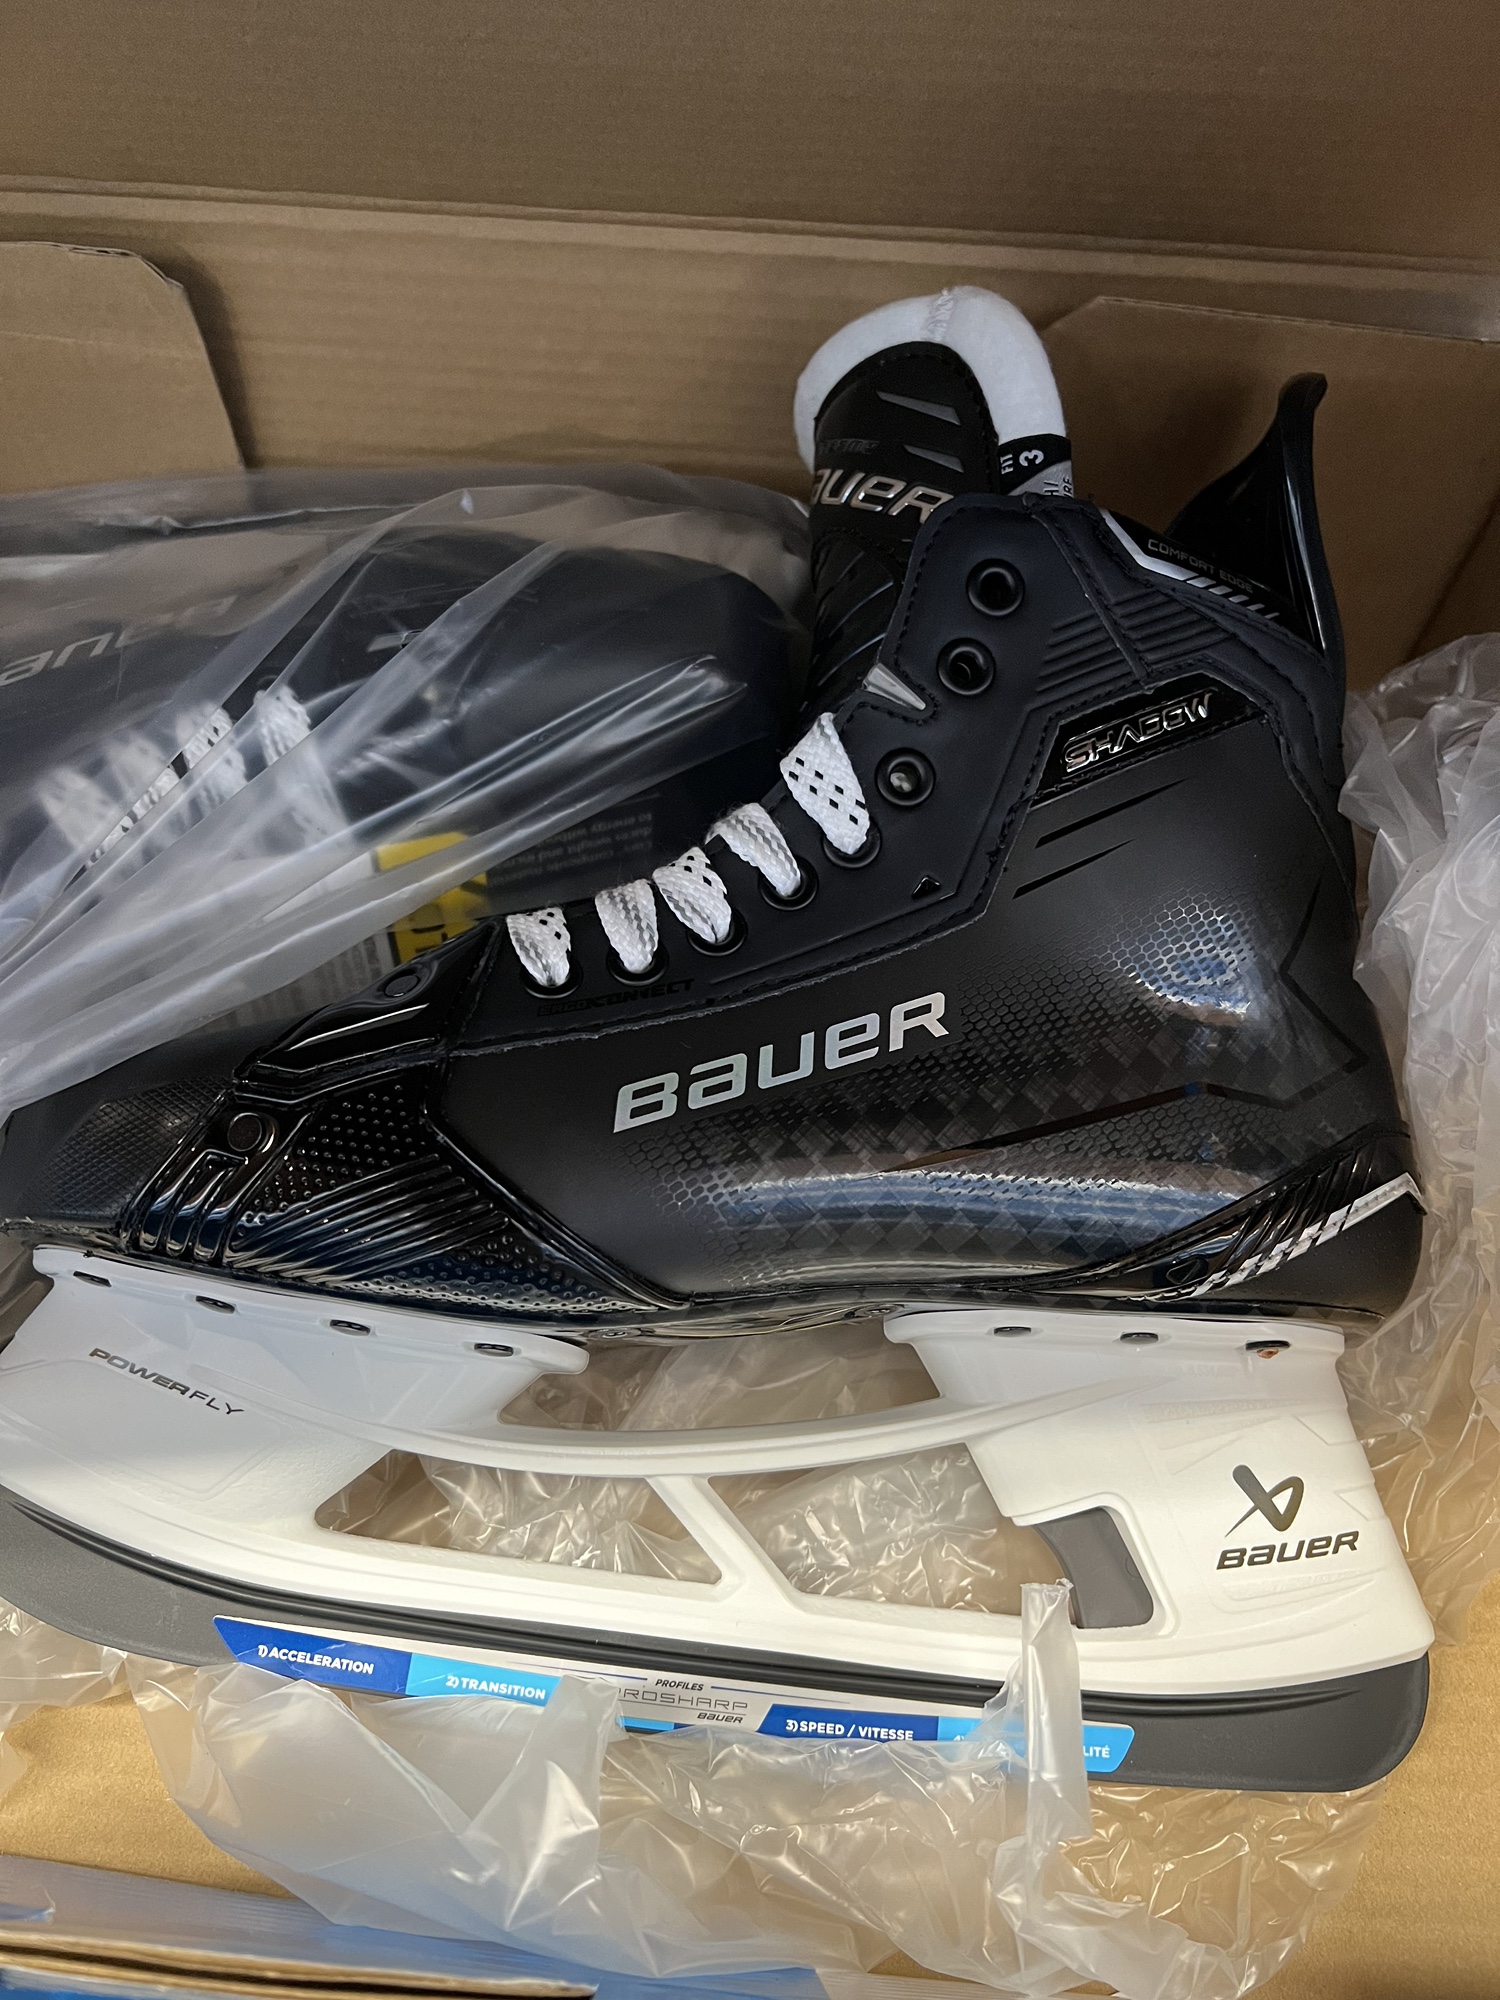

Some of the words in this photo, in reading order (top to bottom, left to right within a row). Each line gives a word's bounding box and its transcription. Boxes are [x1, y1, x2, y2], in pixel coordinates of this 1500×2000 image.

[1000, 454, 1014, 475] FIT
[1019, 449, 1044, 467] 3
[1148, 539, 1215, 574] COMFORT
[1219, 569, 1253, 594] EDGE
[1065, 692, 1213, 772] SHADOW
[613, 992, 949, 1133] BAUER
[89, 1347, 245, 1415] POWERFLY
[1216, 1530, 1359, 1570] BAUER
[655, 1679, 704, 1691] PROFILES
[619, 1688, 748, 1711] ROSHARP
[697, 1712, 743, 1724] BAUER
[858, 1726, 914, 1741] VITESSE
[1083, 1745, 1111, 1758] LITÉ
